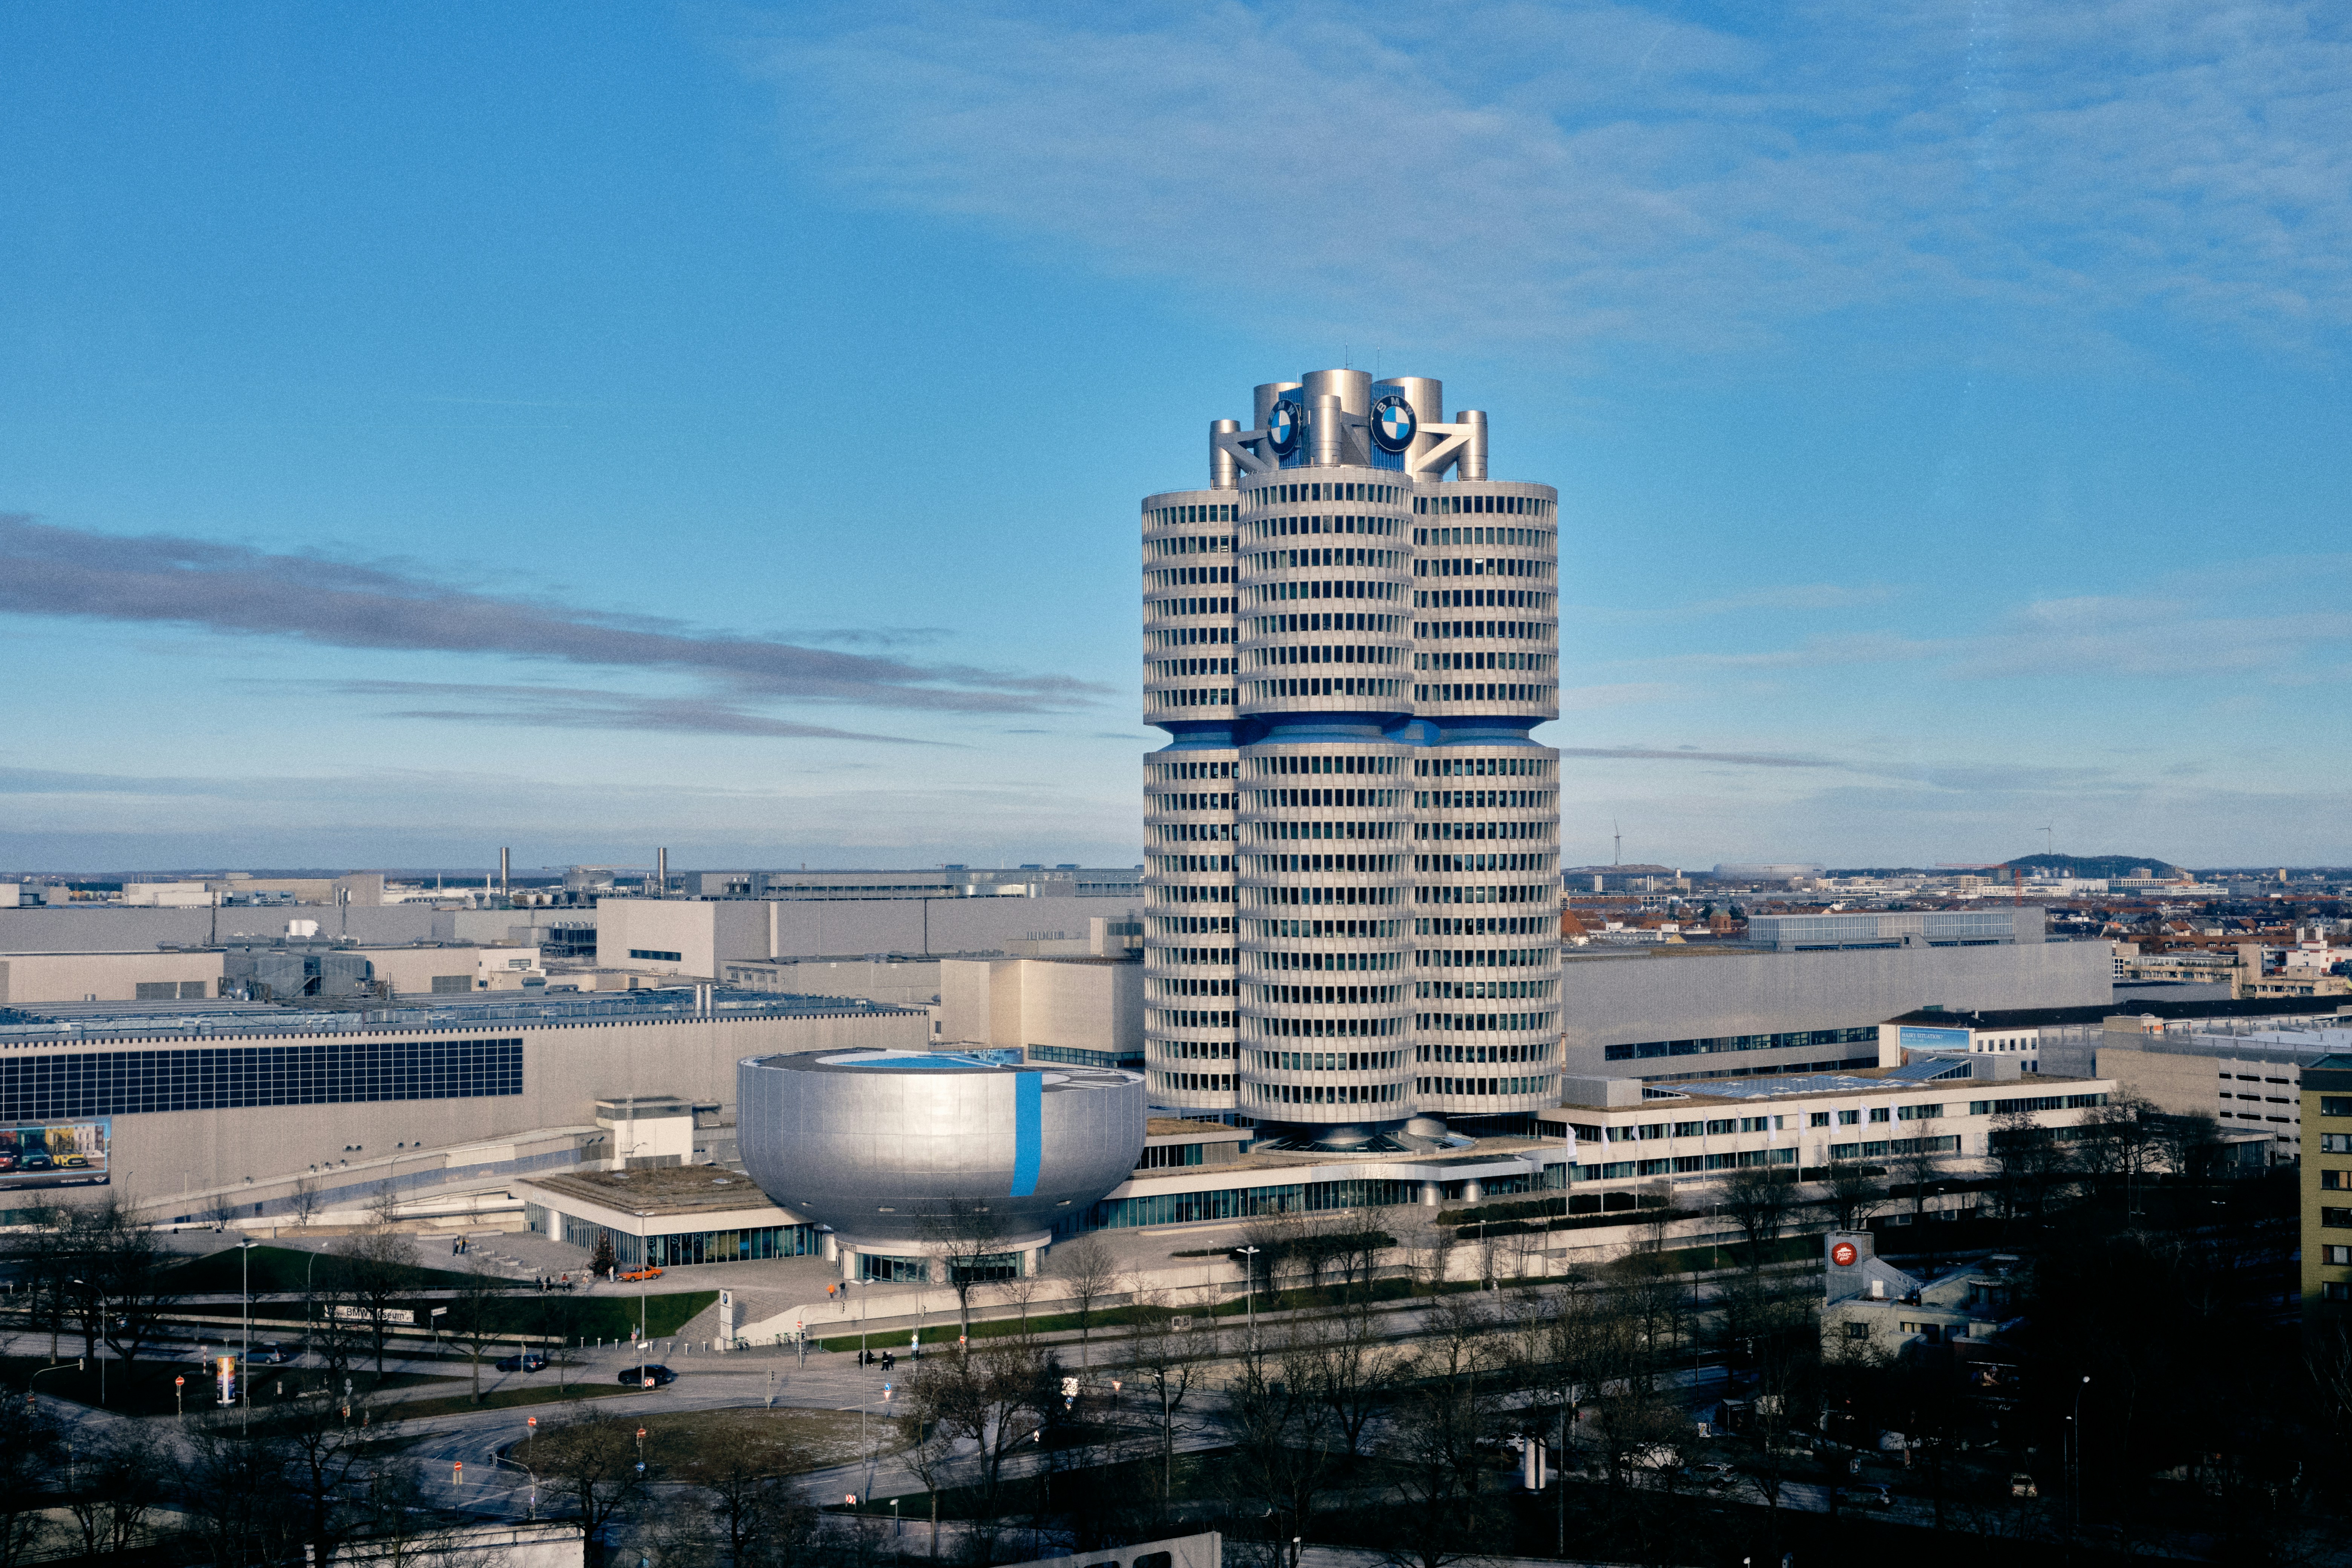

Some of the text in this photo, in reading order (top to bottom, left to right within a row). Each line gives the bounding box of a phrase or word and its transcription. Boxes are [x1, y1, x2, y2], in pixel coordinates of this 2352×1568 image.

[1269, 401, 1295, 420] BMW
[1377, 397, 1413, 415] BMW
[346, 1308, 367, 1317] BMW
